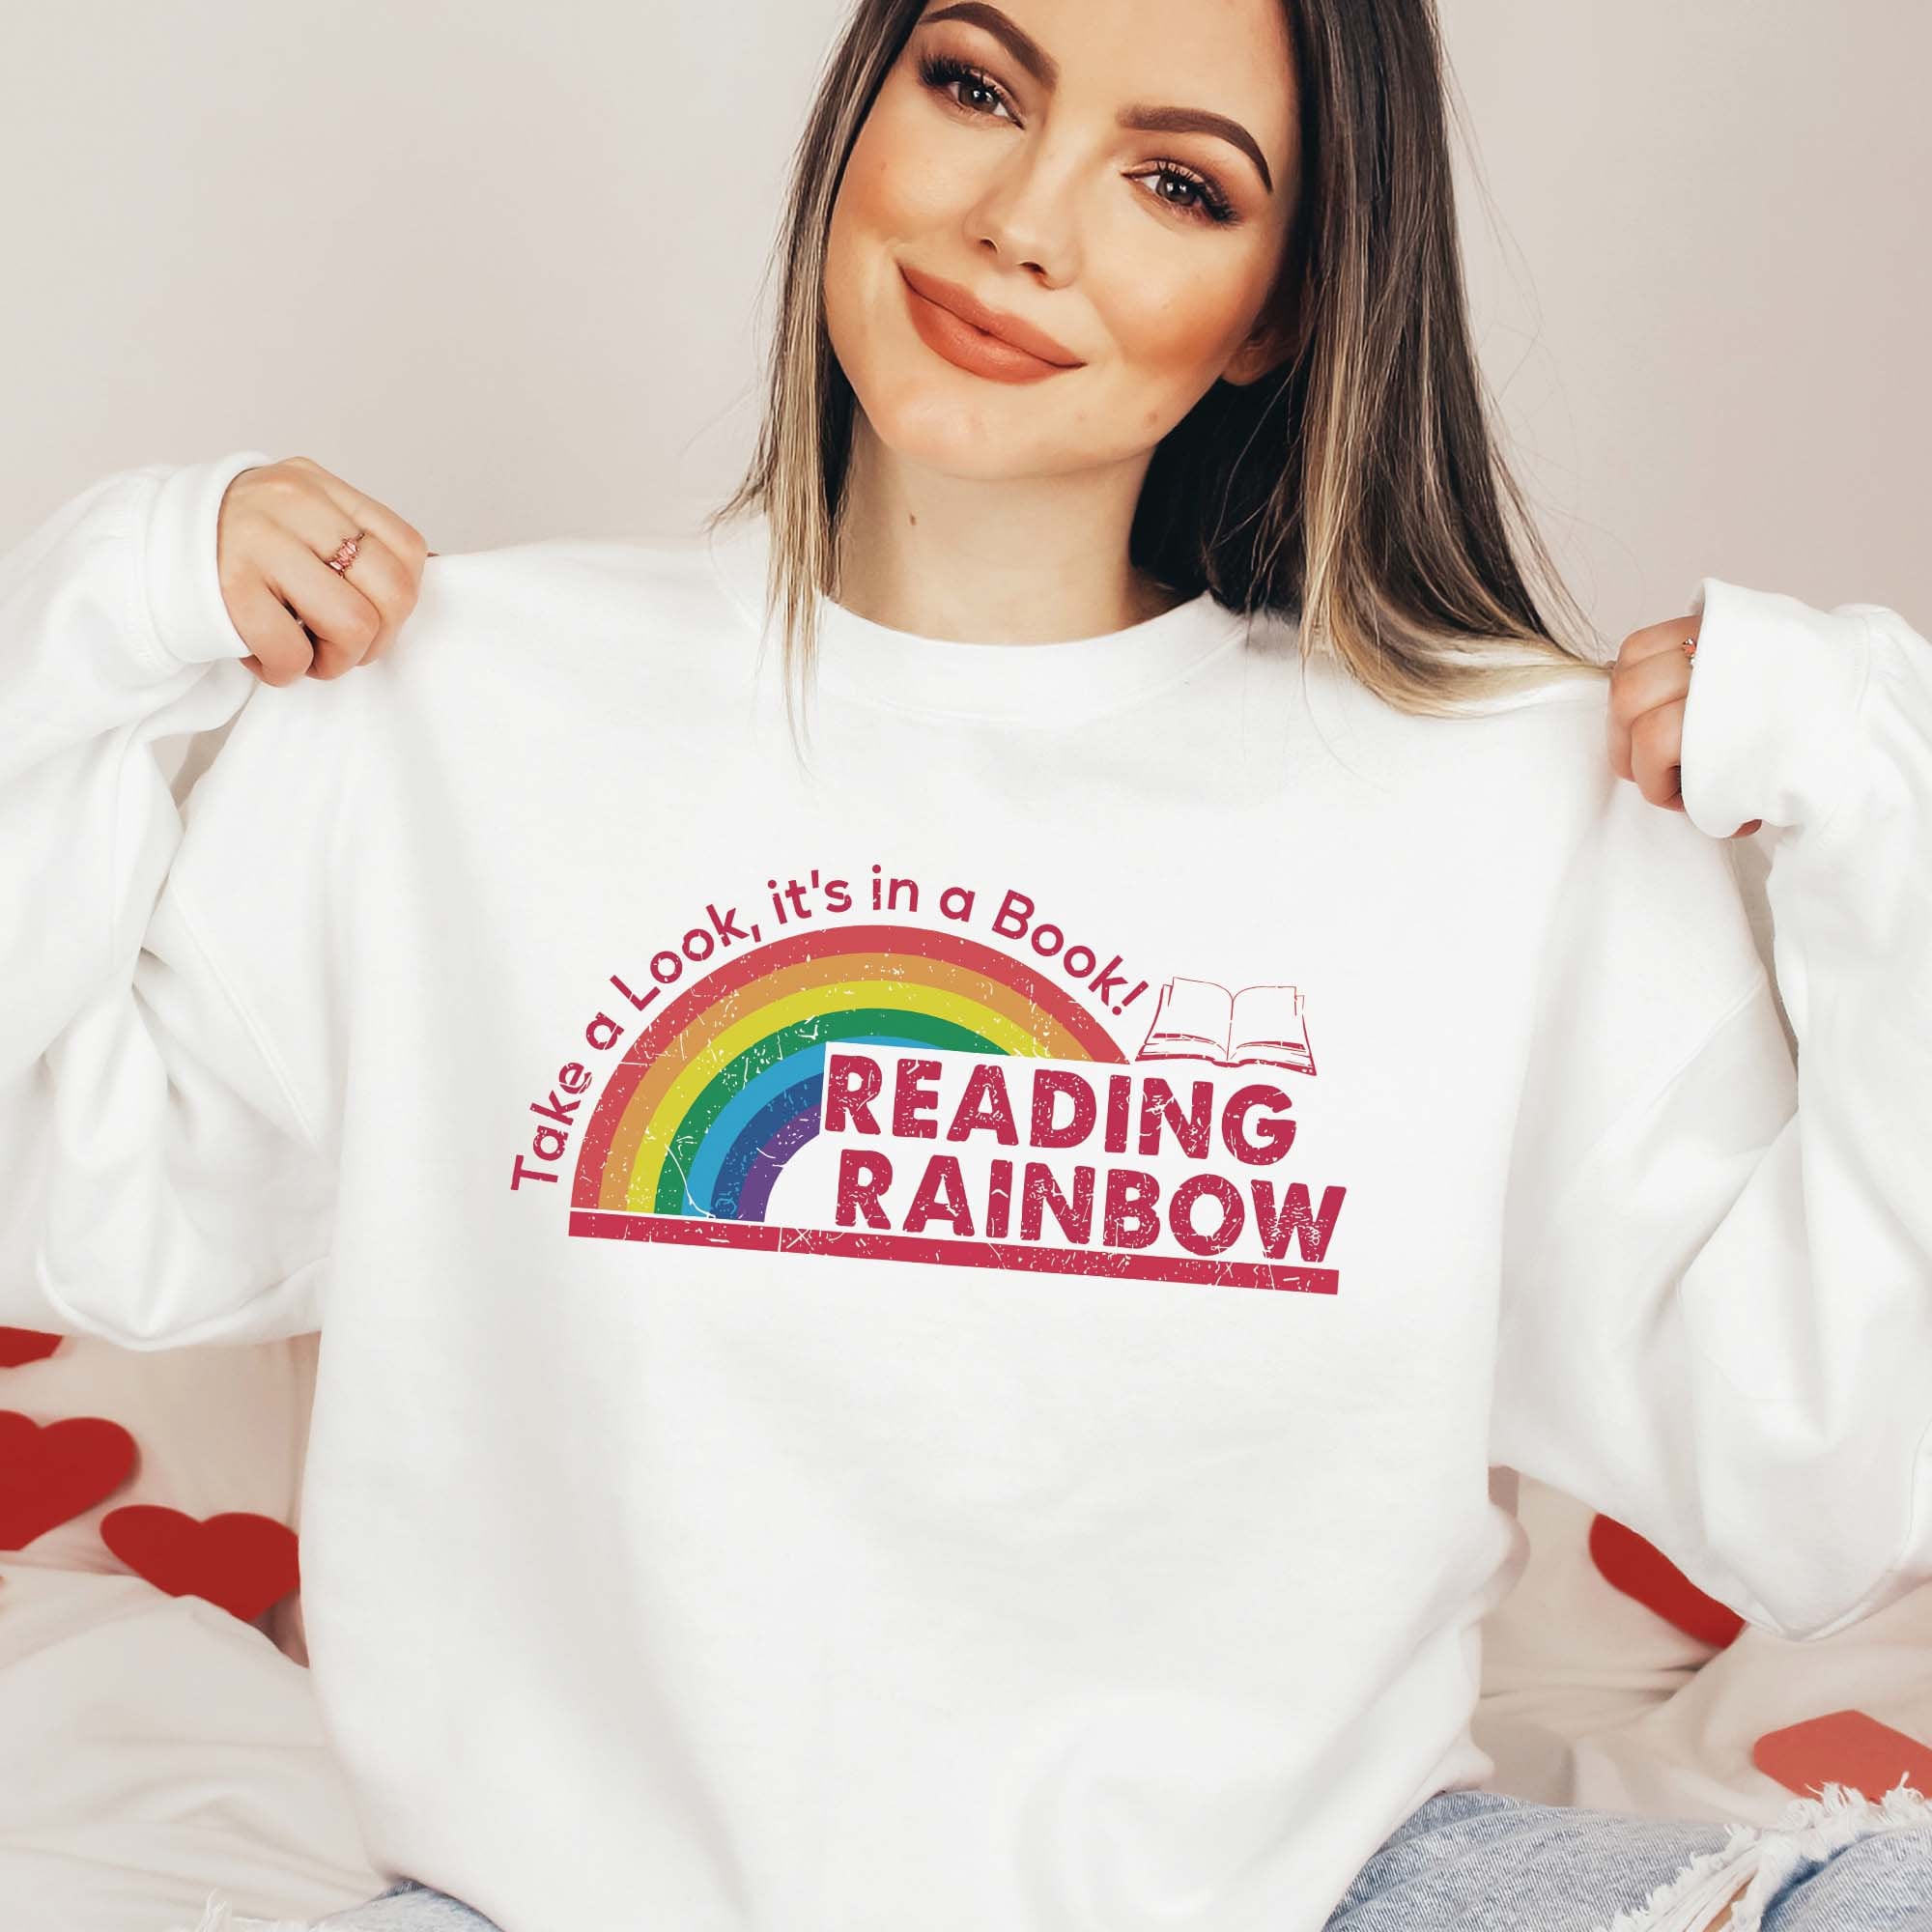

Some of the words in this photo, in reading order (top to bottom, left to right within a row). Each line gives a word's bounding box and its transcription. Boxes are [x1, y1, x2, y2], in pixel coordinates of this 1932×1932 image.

[511, 1063, 592, 1190] Take
[586, 1013, 624, 1050] a
[611, 904, 760, 1011] Look,
[768, 869, 851, 924] it's
[872, 865, 919, 912] in
[940, 887, 975, 922] a
[993, 890, 1149, 1016] Book!
[825, 1055, 1296, 1166] READING
[836, 1149, 1347, 1263] RAINBOW
